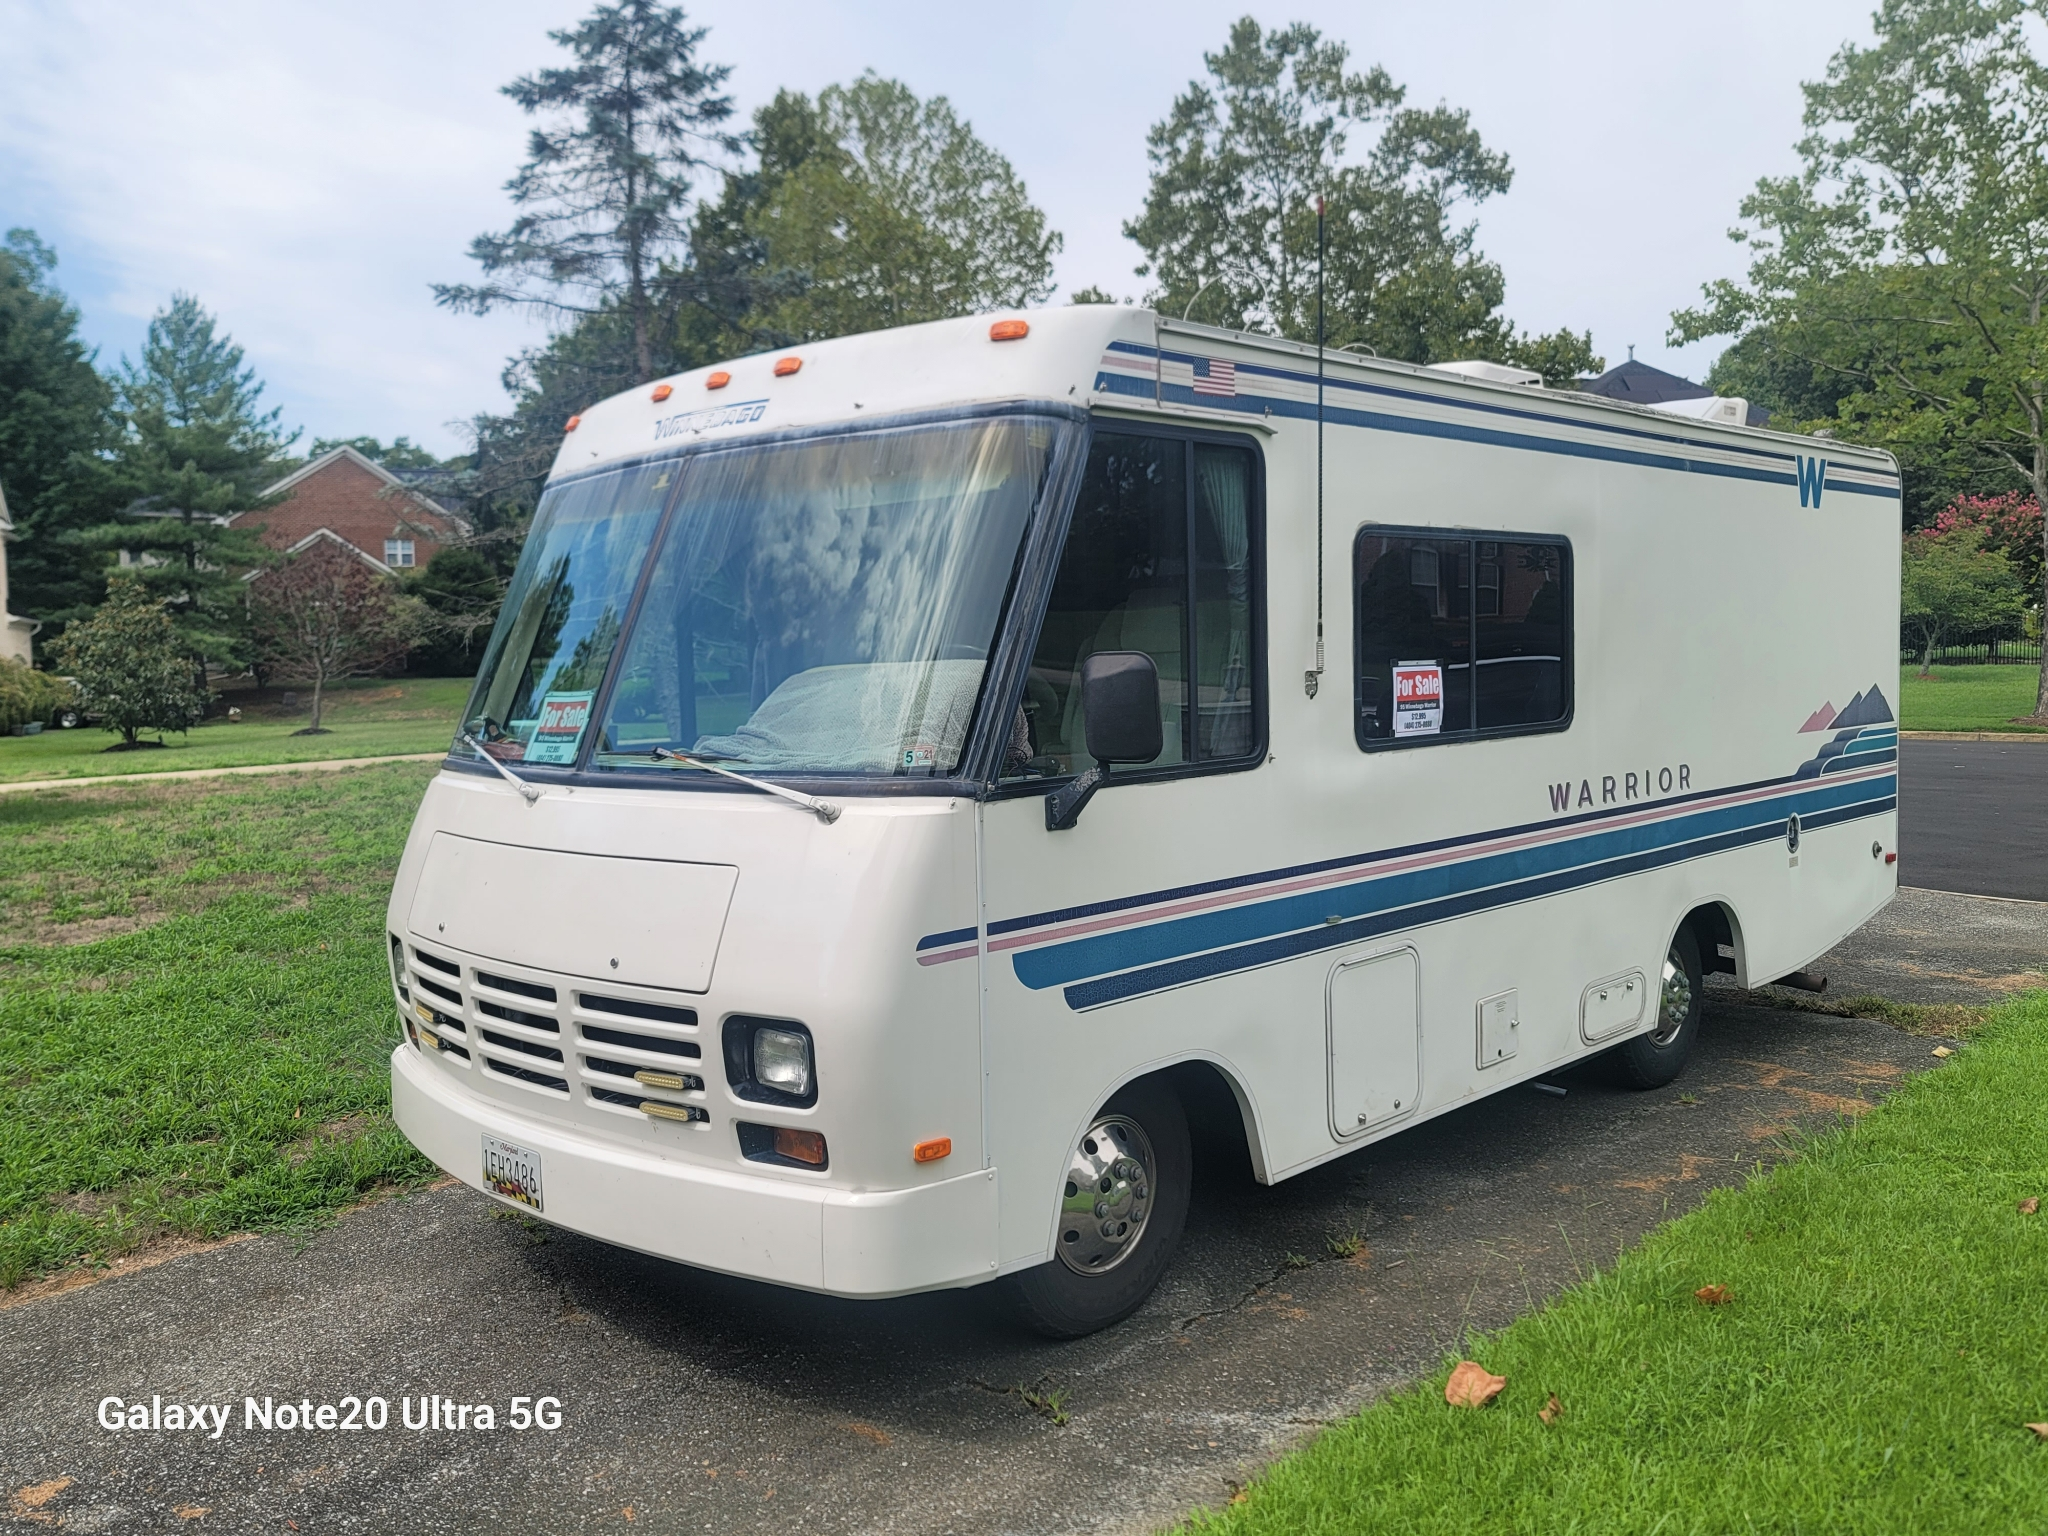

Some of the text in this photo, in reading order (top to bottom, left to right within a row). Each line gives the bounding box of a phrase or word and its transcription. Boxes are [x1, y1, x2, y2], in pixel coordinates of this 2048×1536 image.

[1796, 454, 1827, 509] W
[1396, 674, 1440, 697] For Sale
[541, 705, 586, 728] For Sale
[905, 750, 914, 764] 5
[1548, 763, 1691, 813] WARRIOR
